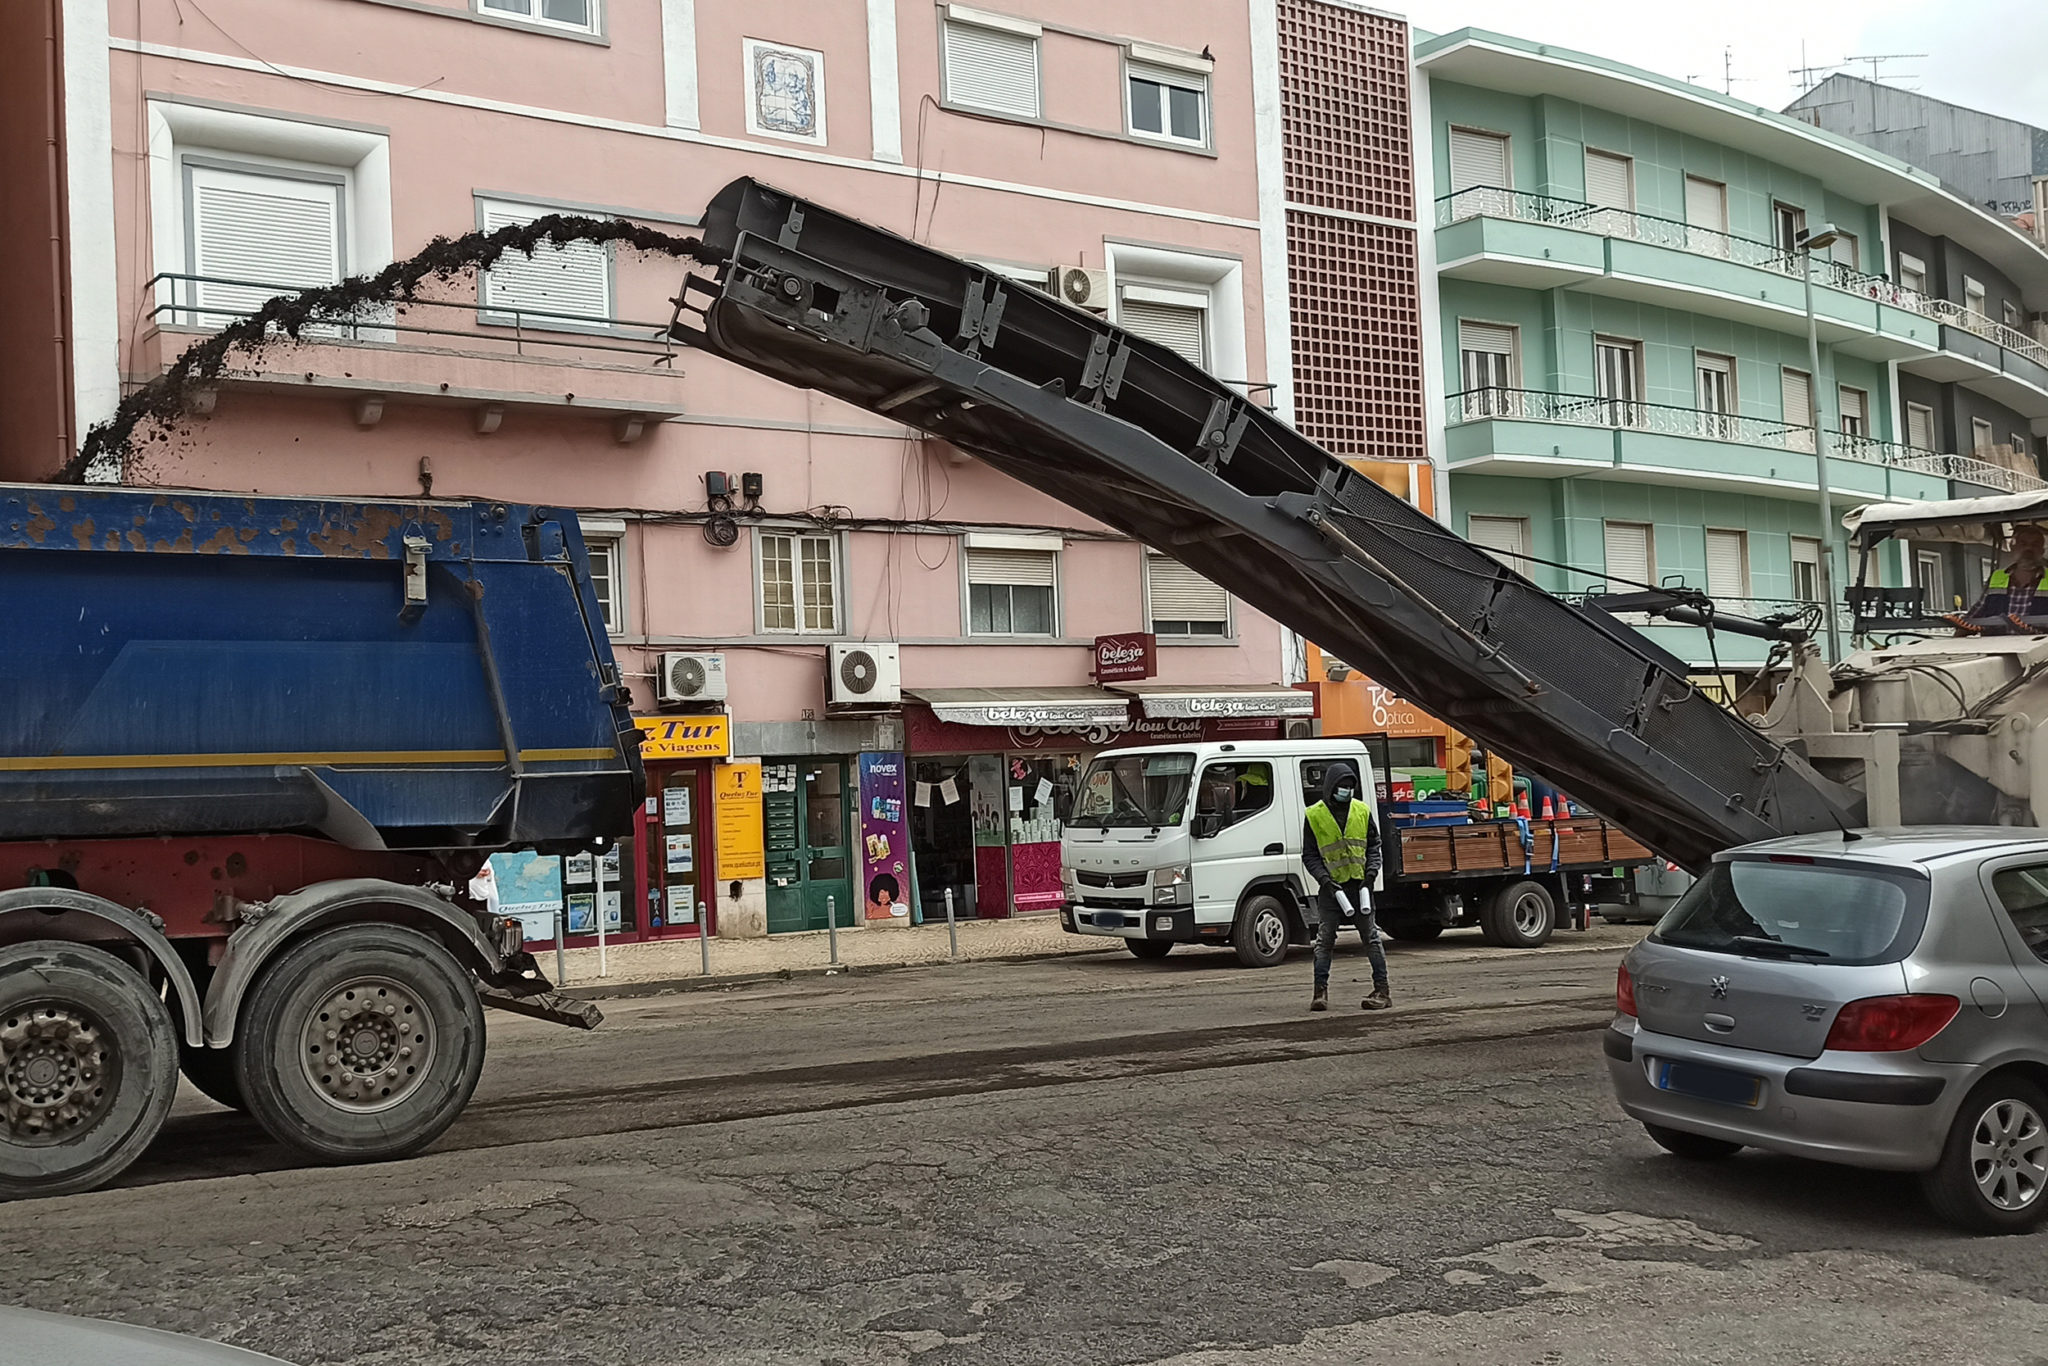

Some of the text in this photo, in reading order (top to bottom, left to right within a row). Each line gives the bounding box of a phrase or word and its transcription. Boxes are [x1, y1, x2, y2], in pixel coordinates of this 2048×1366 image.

[1101, 646, 1144, 661] beleza
[988, 707, 1048, 724] beleza
[1190, 699, 1245, 716] beleza
[661, 720, 720, 739] Tur
[1135, 718, 1165, 732] low
[658, 743, 720, 753] Viagens
[870, 764, 897, 773] novex
[733, 771, 747, 788] T
